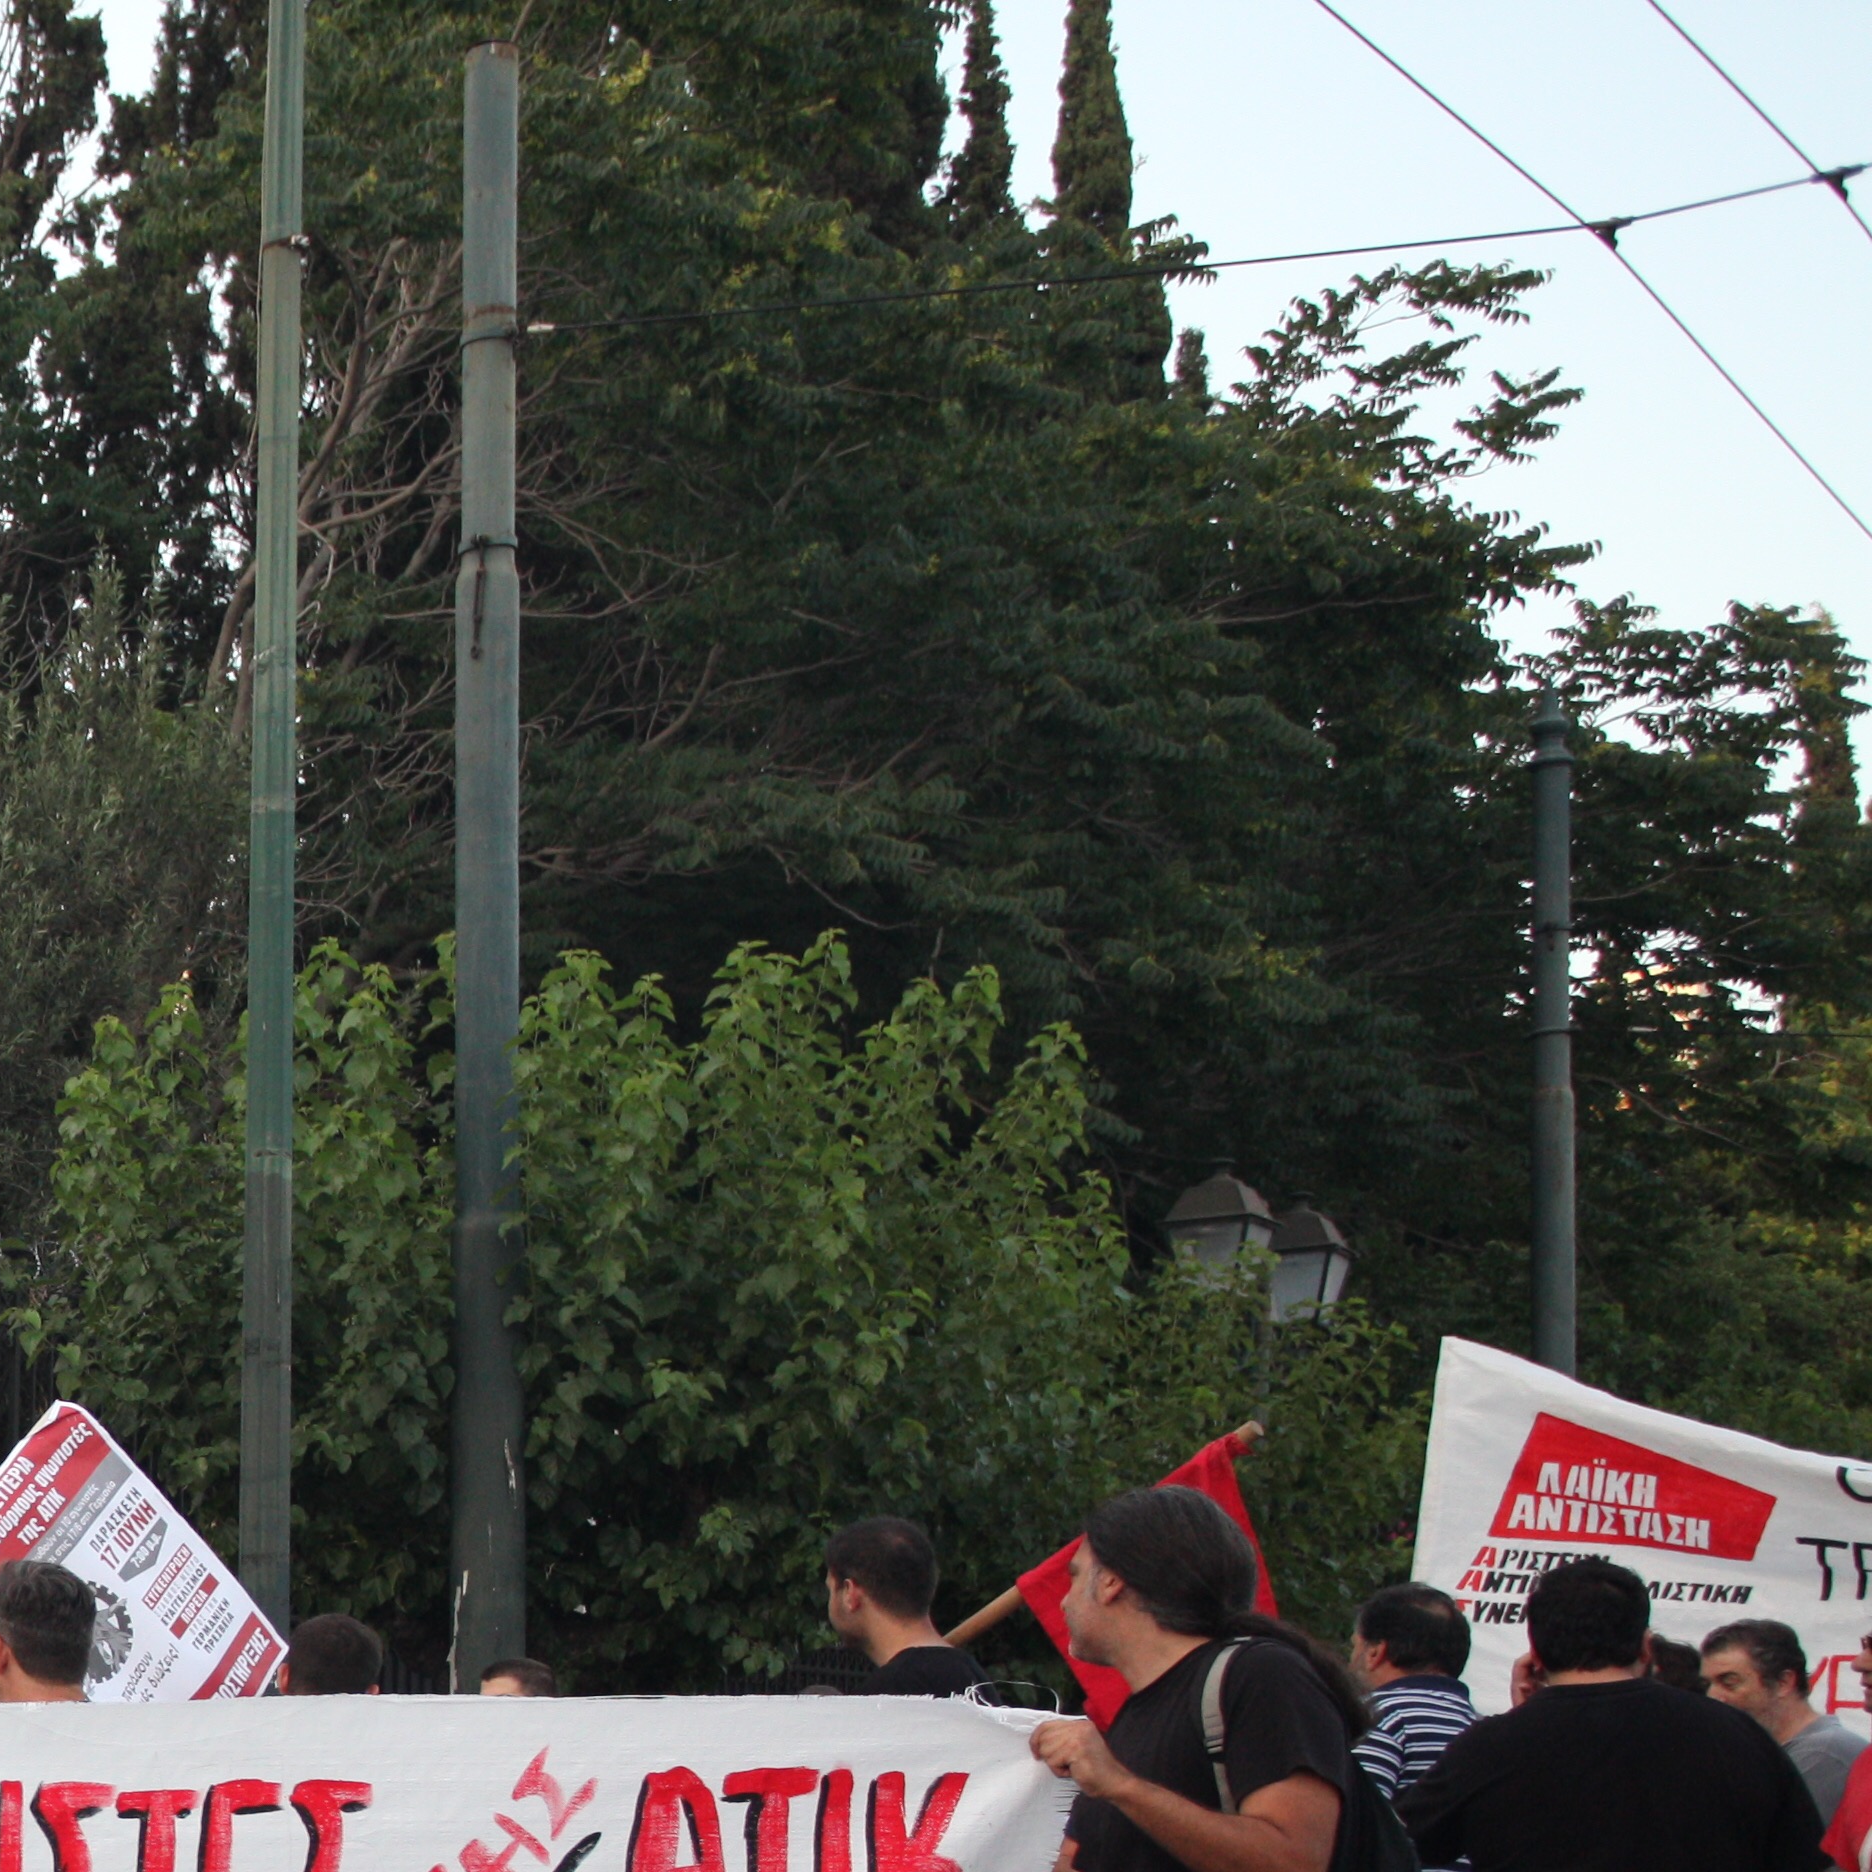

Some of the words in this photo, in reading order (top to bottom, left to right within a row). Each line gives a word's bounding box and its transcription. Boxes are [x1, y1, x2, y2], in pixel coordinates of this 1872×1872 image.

[1535, 1457, 1658, 1509] ΛΑΪΚΗ
[16, 1515, 45, 1545] της
[88, 1486, 142, 1552] ΠΑΡΑΣΚΕΥΗ
[99, 1544, 120, 1570] 17
[112, 1497, 157, 1553] ΙΟΥΝΗ
[1506, 1493, 1711, 1550] ΑΝΤΙΣΤΑΣΗ
[129, 1544, 150, 1568] 7:00
[143, 1545, 190, 1607] ΣΥΓΚΕΝΤΡΩΣΗ
[1471, 1546, 1611, 1573] ΑΡΙΣΤΕ
[160, 1562, 207, 1626] ΕΥΑΓΓΕΛΙΣΜΟΣ
[179, 1589, 208, 1624] ΠΟΡΕΙΑ
[191, 1597, 230, 1650] ΓΕΡΜΑΝΙΚΗ
[203, 1611, 234, 1654] ΠΡΕΣΒΕΙΑ
